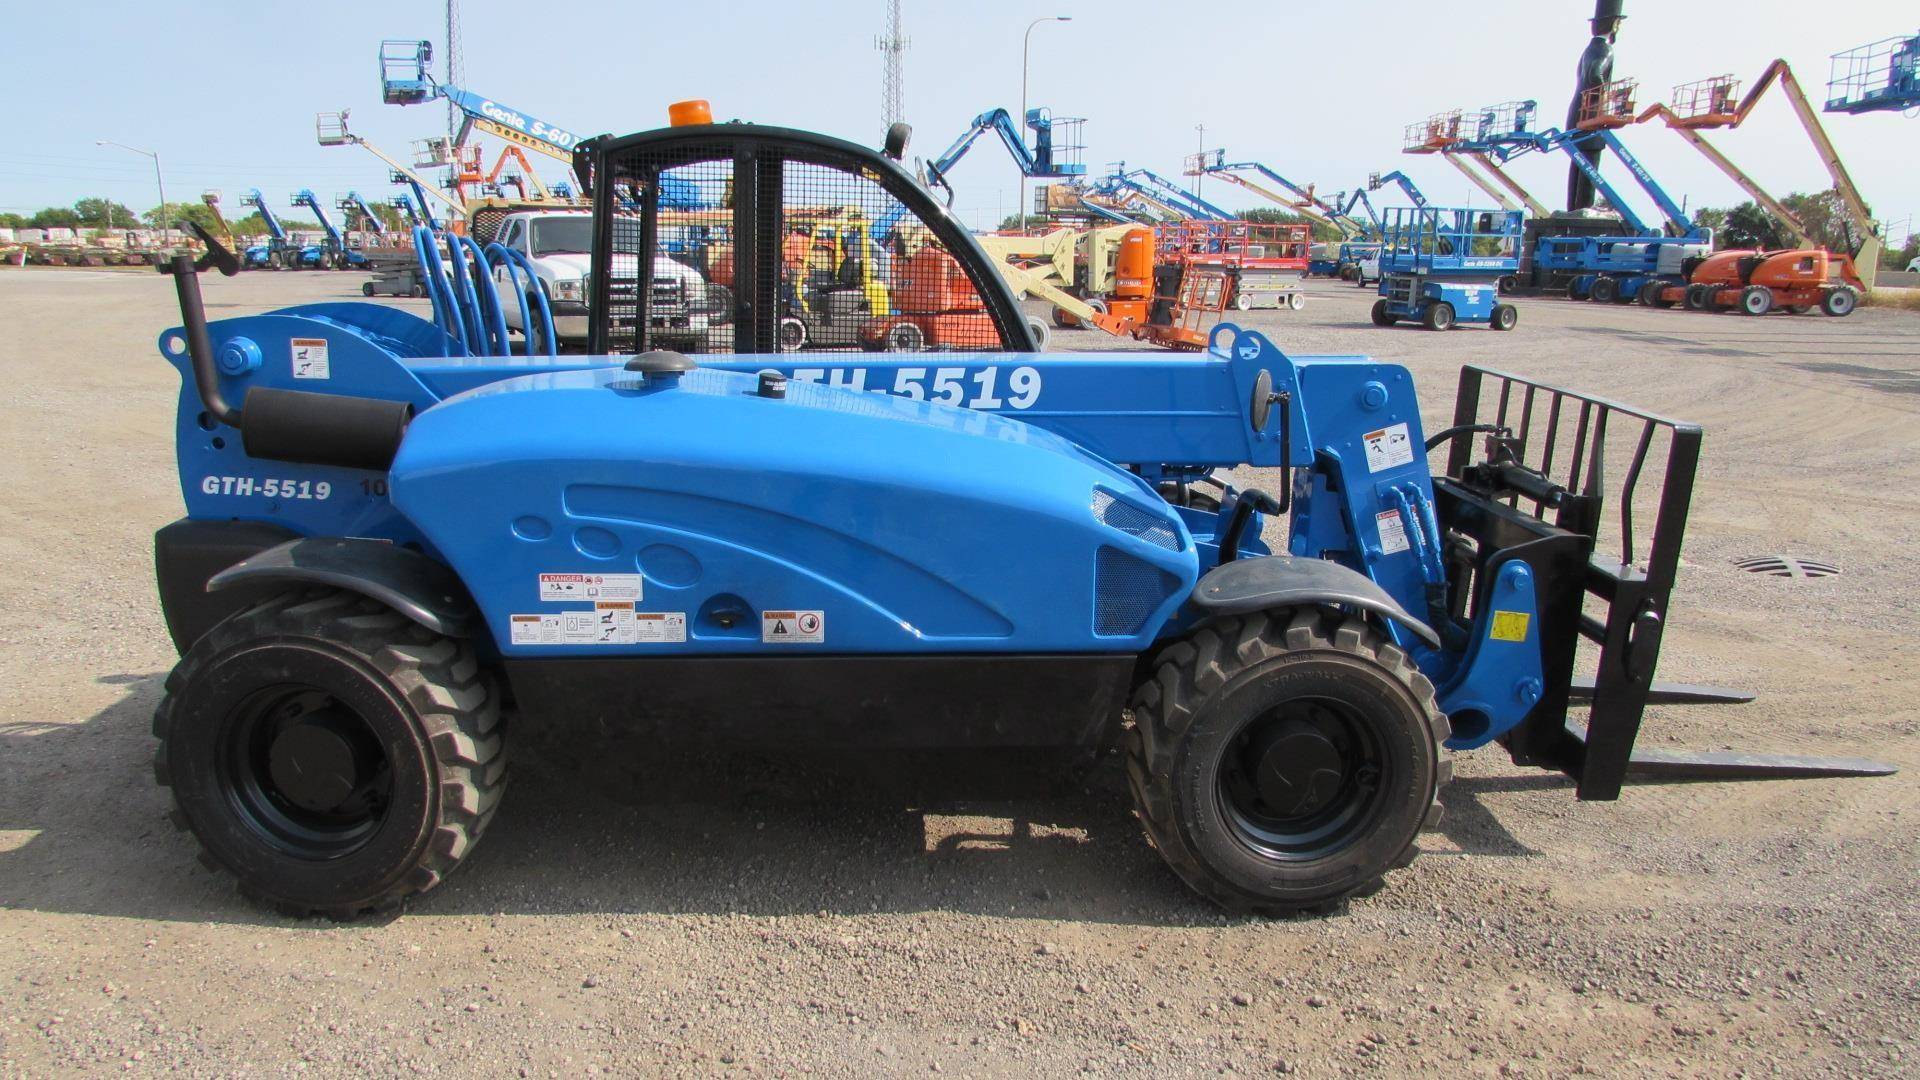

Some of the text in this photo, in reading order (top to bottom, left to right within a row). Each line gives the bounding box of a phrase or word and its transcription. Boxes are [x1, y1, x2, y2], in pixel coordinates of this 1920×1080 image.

[482, 100, 526, 130] Genie
[531, 121, 571, 147] S-60
[756, 366, 1041, 409] TH-5519
[202, 475, 332, 500] GTH-5519
[550, 575, 582, 583] DANGER
